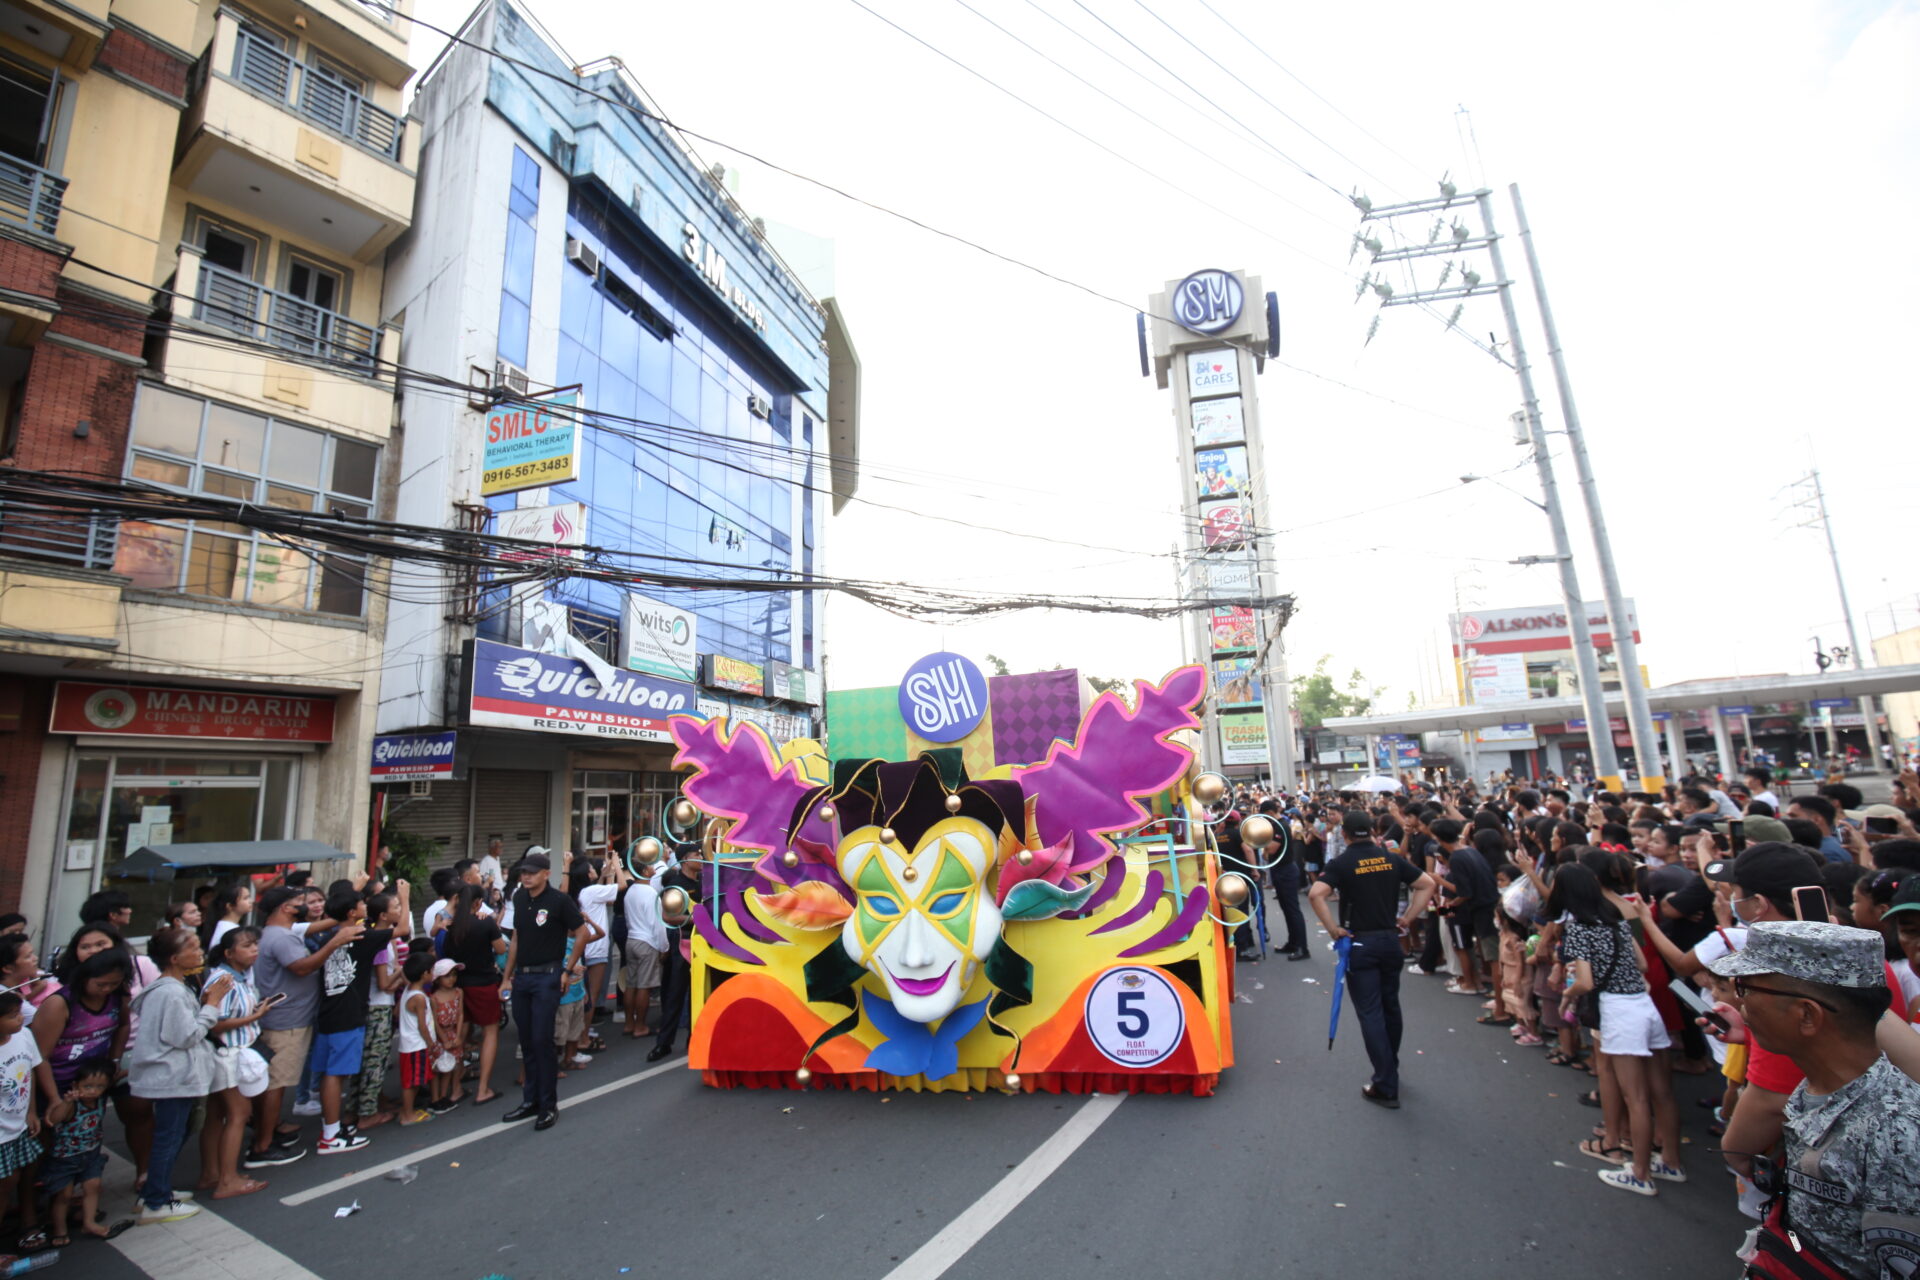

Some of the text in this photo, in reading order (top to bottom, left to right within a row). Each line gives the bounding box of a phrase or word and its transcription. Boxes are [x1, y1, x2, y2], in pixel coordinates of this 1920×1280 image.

[1183, 274, 1233, 325] SM
[1195, 372, 1234, 386] CARES
[488, 406, 548, 443] SMLC
[486, 440, 533, 456] BEHAVIORAL
[535, 433, 571, 447] THERAPY
[1199, 453, 1226, 463] Enjoy
[483, 457, 569, 483] 0916-567-3483
[1483, 613, 1568, 635] ALSON'S
[493, 657, 686, 711] Quickloan
[147, 691, 311, 718] MANDARIN
[906, 658, 978, 733] SM
[145, 711, 309, 729] CHINESE DRUG CENTER
[546, 707, 653, 728] PAWNSHOP
[533, 718, 658, 739] RED-V BRANCH
[1224, 725, 1265, 741] TRASH
[375, 739, 454, 763] Quickloan
[389, 764, 435, 773] PAWNSHOP
[1355, 864, 1393, 875] SECURITY
[1358, 857, 1385, 867] EVENT
[1117, 991, 1150, 1039] 5
[68, 1044, 84, 1060] 5
[1116, 1049, 1159, 1057] COMPETITION
[1126, 1041, 1146, 1049] FLOAT
[1809, 1180, 1847, 1200] FORCE
